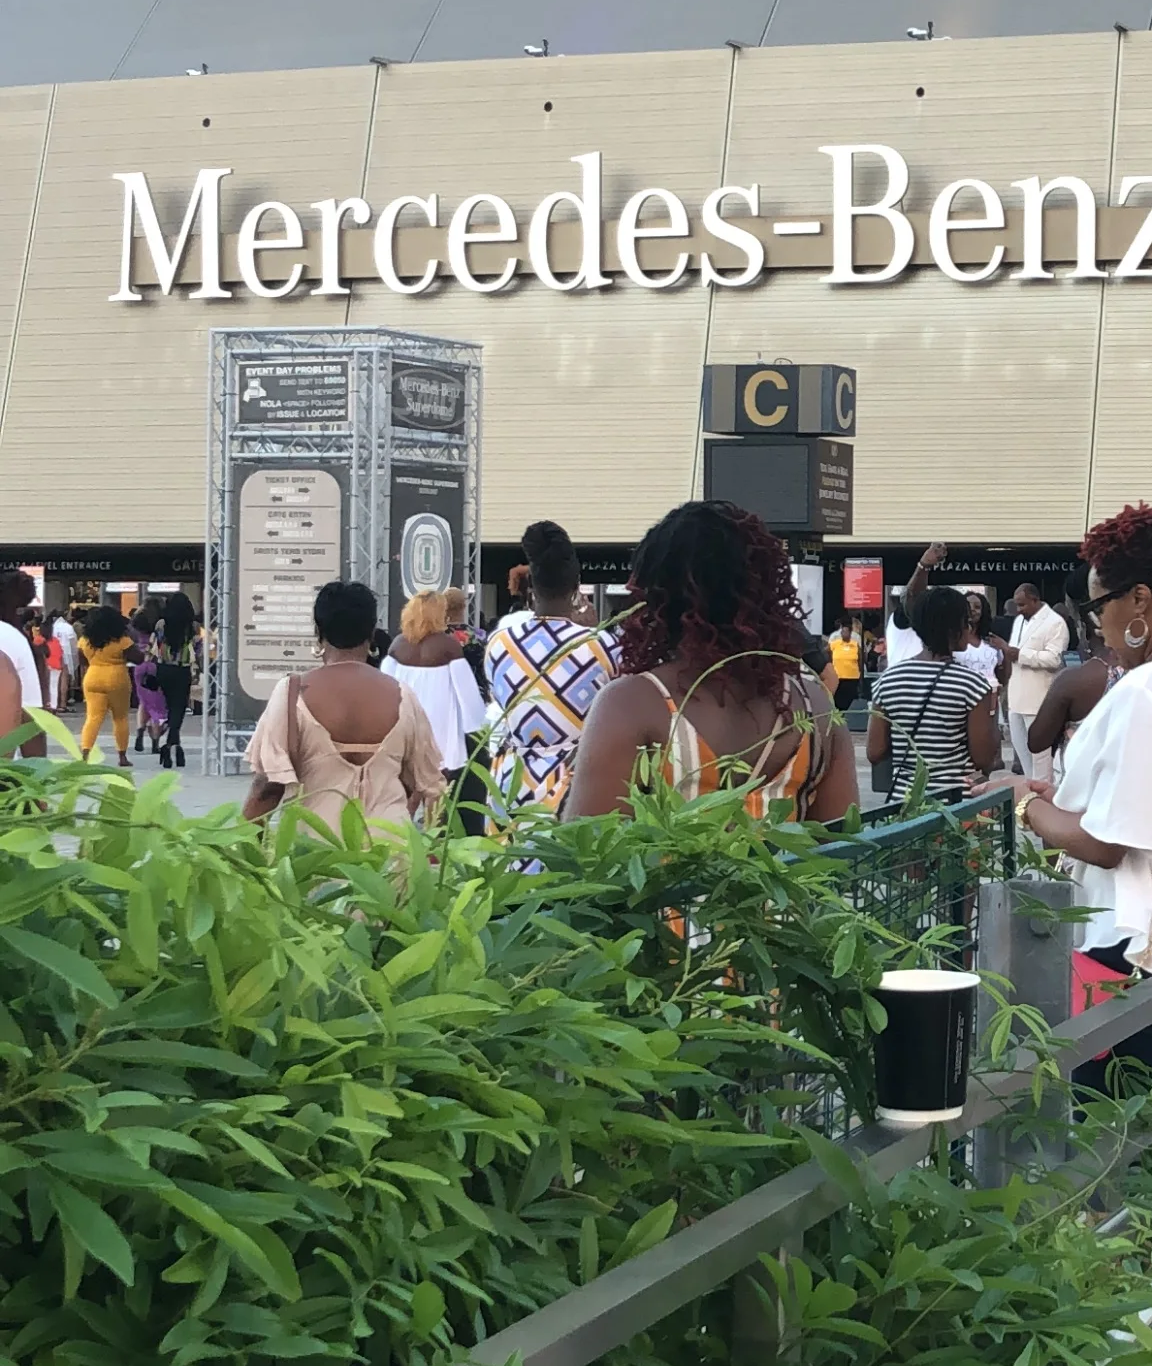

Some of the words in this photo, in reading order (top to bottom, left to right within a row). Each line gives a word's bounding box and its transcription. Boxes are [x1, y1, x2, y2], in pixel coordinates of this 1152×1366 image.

[246, 367, 274, 376] EVENT
[276, 366, 293, 375] DAY
[295, 365, 342, 375] PROBLEMS
[399, 376, 461, 399] Mercedes-Benz
[744, 370, 789, 426] C
[835, 372, 853, 430] C
[260, 400, 282, 408] NOLA
[406, 397, 454, 417] Superdome
[276, 410, 299, 418] ISSUE
[306, 408, 347, 417] LOCATION
[61, 561, 112, 571] ENTRANCE
[172, 559, 205, 572] GATE
[582, 561, 617, 571] PLAZA
[933, 561, 971, 571] PLAZA
[974, 561, 1008, 572] LEVEL
[1012, 561, 1076, 572] ENTRANCE
